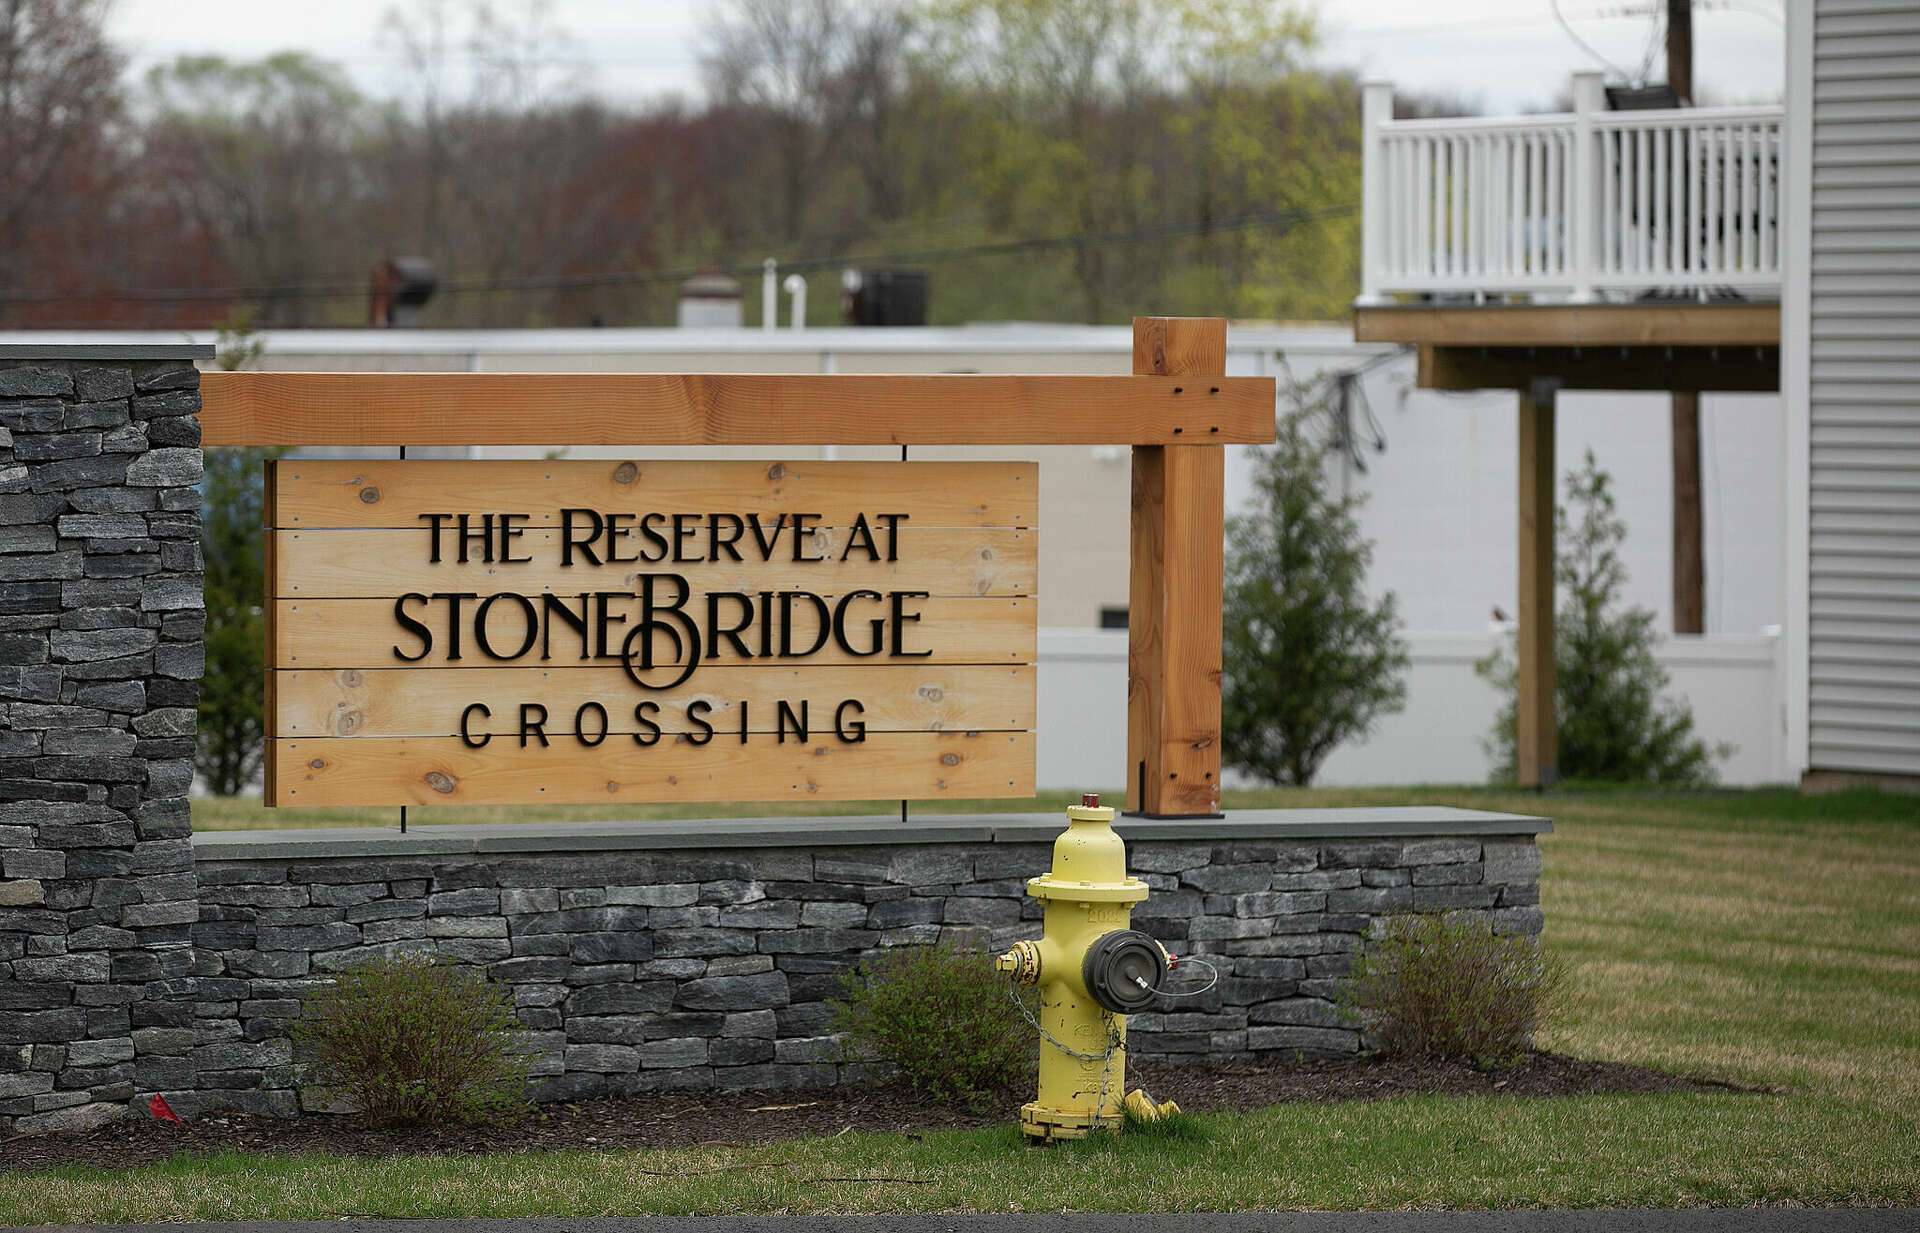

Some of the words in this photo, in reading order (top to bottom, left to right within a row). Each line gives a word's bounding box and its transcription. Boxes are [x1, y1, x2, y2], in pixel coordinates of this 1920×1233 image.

[418, 513, 532, 563] THE
[560, 508, 823, 566] RESERVE
[839, 512, 910, 563] AT
[393, 573, 933, 690] STONEBRIDGE
[460, 699, 867, 749] CROSSING
